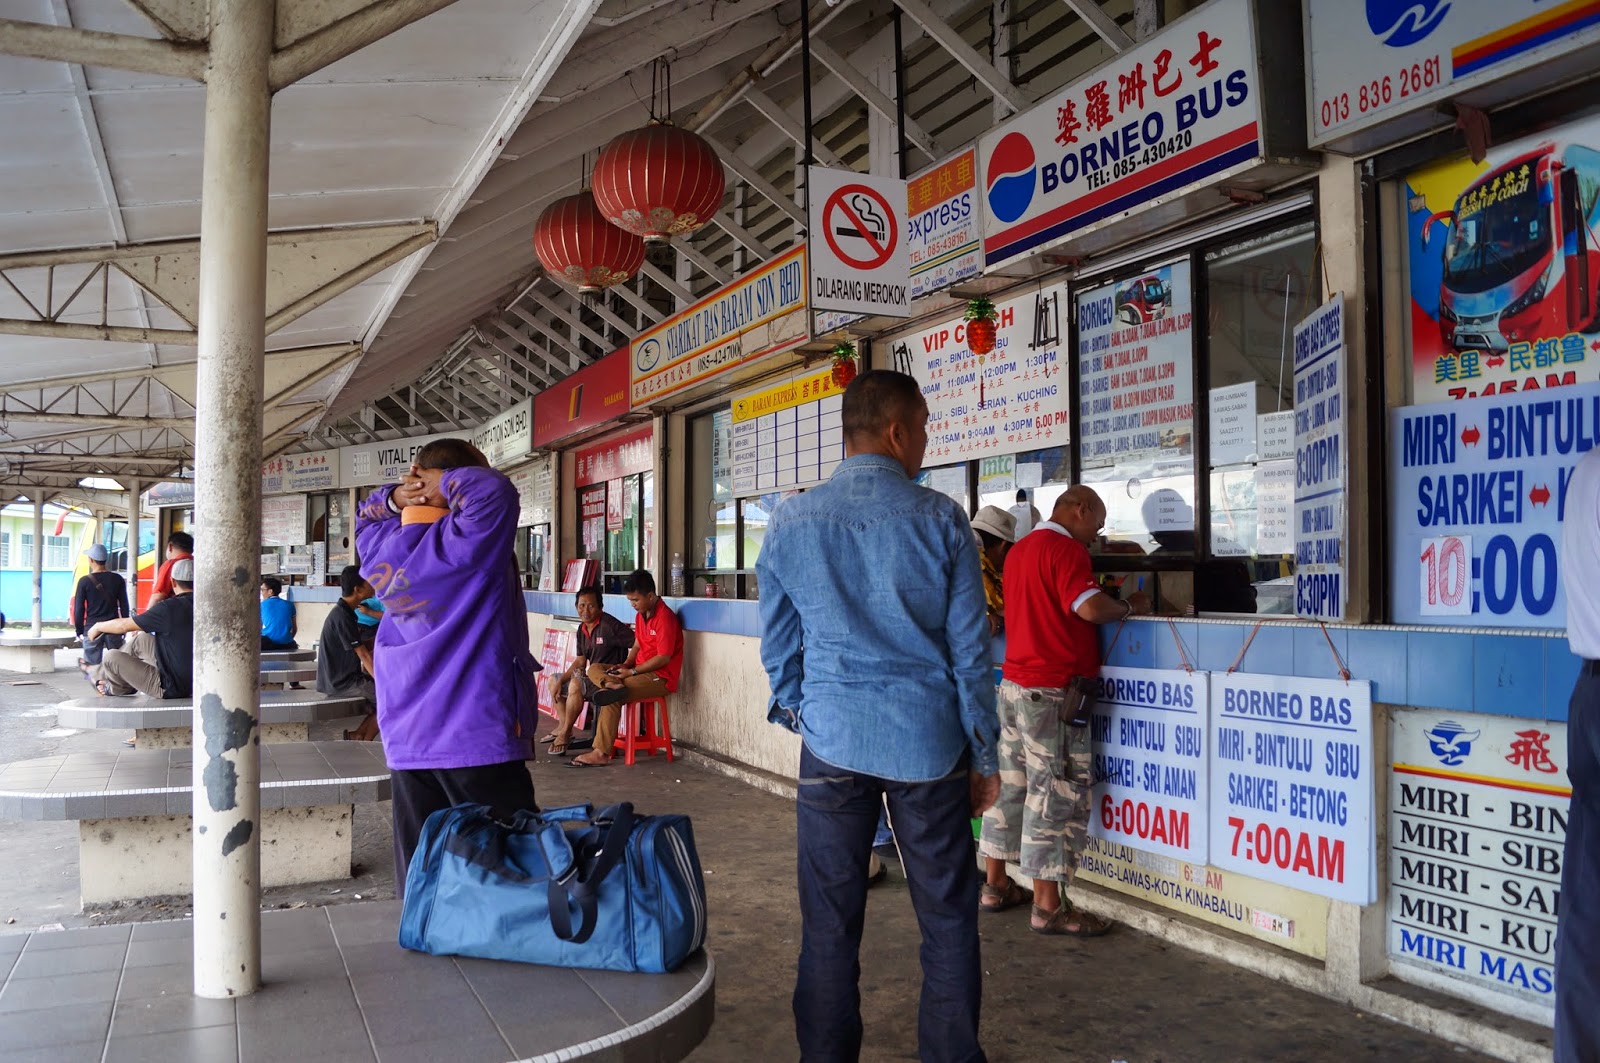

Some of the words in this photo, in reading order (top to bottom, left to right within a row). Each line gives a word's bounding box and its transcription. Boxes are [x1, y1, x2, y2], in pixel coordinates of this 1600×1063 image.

[1054, 30, 1222, 147] 婆羅洲巴士
[1321, 93, 1350, 127] 013
[1359, 76, 1392, 113] 836
[1400, 55, 1441, 98] 2681
[1041, 111, 1165, 195] BORNEO
[1175, 69, 1249, 132] BUS
[1086, 170, 1111, 191] TEL:
[1113, 129, 1193, 183] 085-430420
[927, 231, 968, 257] 085-438161
[666, 313, 700, 360] SYARIKAT
[704, 304, 719, 344] BAS
[721, 285, 753, 336] BARAM
[756, 272, 775, 318] SDN
[779, 260, 801, 307] BHD
[817, 277, 861, 301] DILARANG
[864, 281, 907, 306] MEROKOK
[1081, 296, 1112, 332] BORNEO
[923, 329, 949, 353] VIP
[1320, 304, 1340, 349] EXPRESS
[928, 357, 942, 370] MIRI
[947, 373, 976, 388] 11:00AM
[984, 362, 1017, 378] 12:00PM
[1026, 351, 1057, 368] 1:30PM
[1435, 351, 1482, 383] 美里
[1509, 333, 1586, 372] 民都魯
[753, 395, 771, 412] BARAM
[774, 387, 798, 406] EXPRESS
[951, 405, 967, 418] SIBU
[977, 396, 1007, 411] SERIAN
[1017, 385, 1057, 403] KUCHING
[1158, 384, 1175, 402] PASAR
[1328, 392, 1340, 423] ANTU
[935, 432, 961, 446] 7:15AM
[1004, 418, 1033, 433] 4:30PM
[1035, 413, 1053, 430] 6.00
[1055, 411, 1068, 426] PM
[1403, 413, 1456, 467] MIRI
[378, 448, 407, 466] VITAL
[983, 455, 1013, 476] mtc
[1264, 469, 1295, 477] MIRI-BINTU
[1282, 450, 1294, 458] Pasa
[1296, 433, 1339, 489] 8:00PM
[1417, 470, 1523, 527] SARIKEI
[1325, 538, 1340, 563] AMAN
[1297, 573, 1340, 618] 8:30PM
[1097, 677, 1157, 704] BORNEO
[1162, 682, 1194, 708] BAS
[1224, 687, 1303, 721] BORNEO
[1310, 696, 1352, 725] BAS
[1091, 713, 1112, 743] MIRI
[1120, 717, 1165, 752] BINTULU
[1175, 724, 1201, 758] SIBU
[1218, 727, 1244, 762] MIRI
[1255, 732, 1313, 773] BINTULU
[1326, 741, 1360, 780] SIBU
[1505, 729, 1558, 773] 飛
[1095, 753, 1134, 788] SARIKEI
[1144, 762, 1160, 793] SRI
[1164, 766, 1196, 800] AMAN
[1101, 794, 1190, 850] 6:00AM
[1228, 772, 1278, 814] SARIKEI
[1290, 783, 1347, 827] BETONG
[1400, 783, 1469, 818] MIRI
[1510, 801, 1569, 835] BIN
[1103, 840, 1133, 863] JULAU
[1228, 816, 1345, 884] 7:00AM
[1400, 820, 1469, 856] MIRI
[1502, 840, 1561, 875] SIB
[1080, 855, 1183, 900] MBANG-LAWAS-KOTA
[1185, 887, 1242, 921] KINABALU
[1400, 856, 1469, 895] MIRI
[1400, 894, 1468, 934] MIRI
[1501, 919, 1554, 956] KU
[1401, 929, 1466, 969] MIRI
[1480, 952, 1554, 994] MAS
